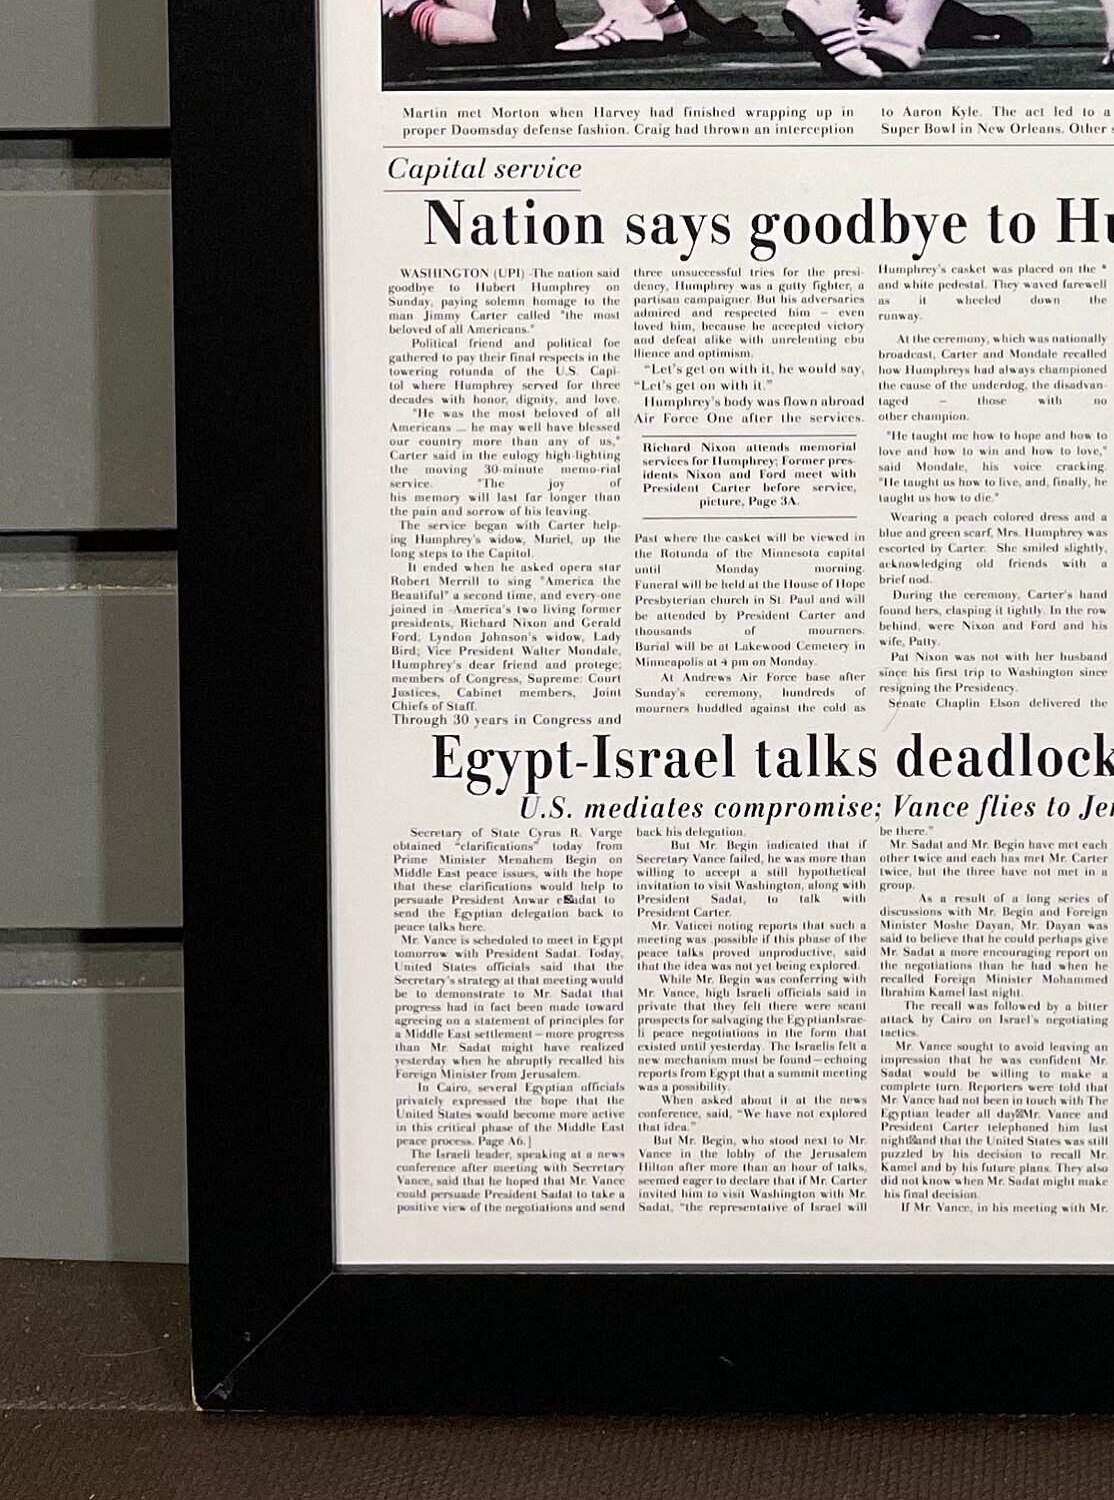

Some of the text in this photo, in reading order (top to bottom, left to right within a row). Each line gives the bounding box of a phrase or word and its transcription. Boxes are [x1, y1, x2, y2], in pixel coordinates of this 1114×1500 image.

[403, 105, 854, 122] Martin met Morton when Harvey had finished wrapping up in
[881, 107, 894, 118] to
[902, 105, 942, 117] Aaron
[991, 105, 1017, 117] The
[1025, 107, 1045, 117] act
[1053, 105, 1073, 117] led
[1082, 107, 1095, 117] to
[1103, 108, 1111, 117] a
[387, 155, 583, 187] Capital service
[424, 199, 604, 245] Nation
[626, 214, 730, 261] says
[750, 198, 967, 262] goodbye
[987, 204, 1036, 245] to
[644, 395, 865, 411] Humphrey’s body was flown abroad
[391, 713, 622, 729] Through 30 years in Congress and
[432, 734, 735, 796] Egypt-Israel
[756, 733, 876, 778] talks
[520, 795, 572, 820] U.S.
[584, 795, 704, 819] mediates
[714, 793, 882, 826] compromise;
[894, 793, 969, 818] Vance
[974, 793, 1037, 826] flies
[1047, 796, 1071, 818] to
